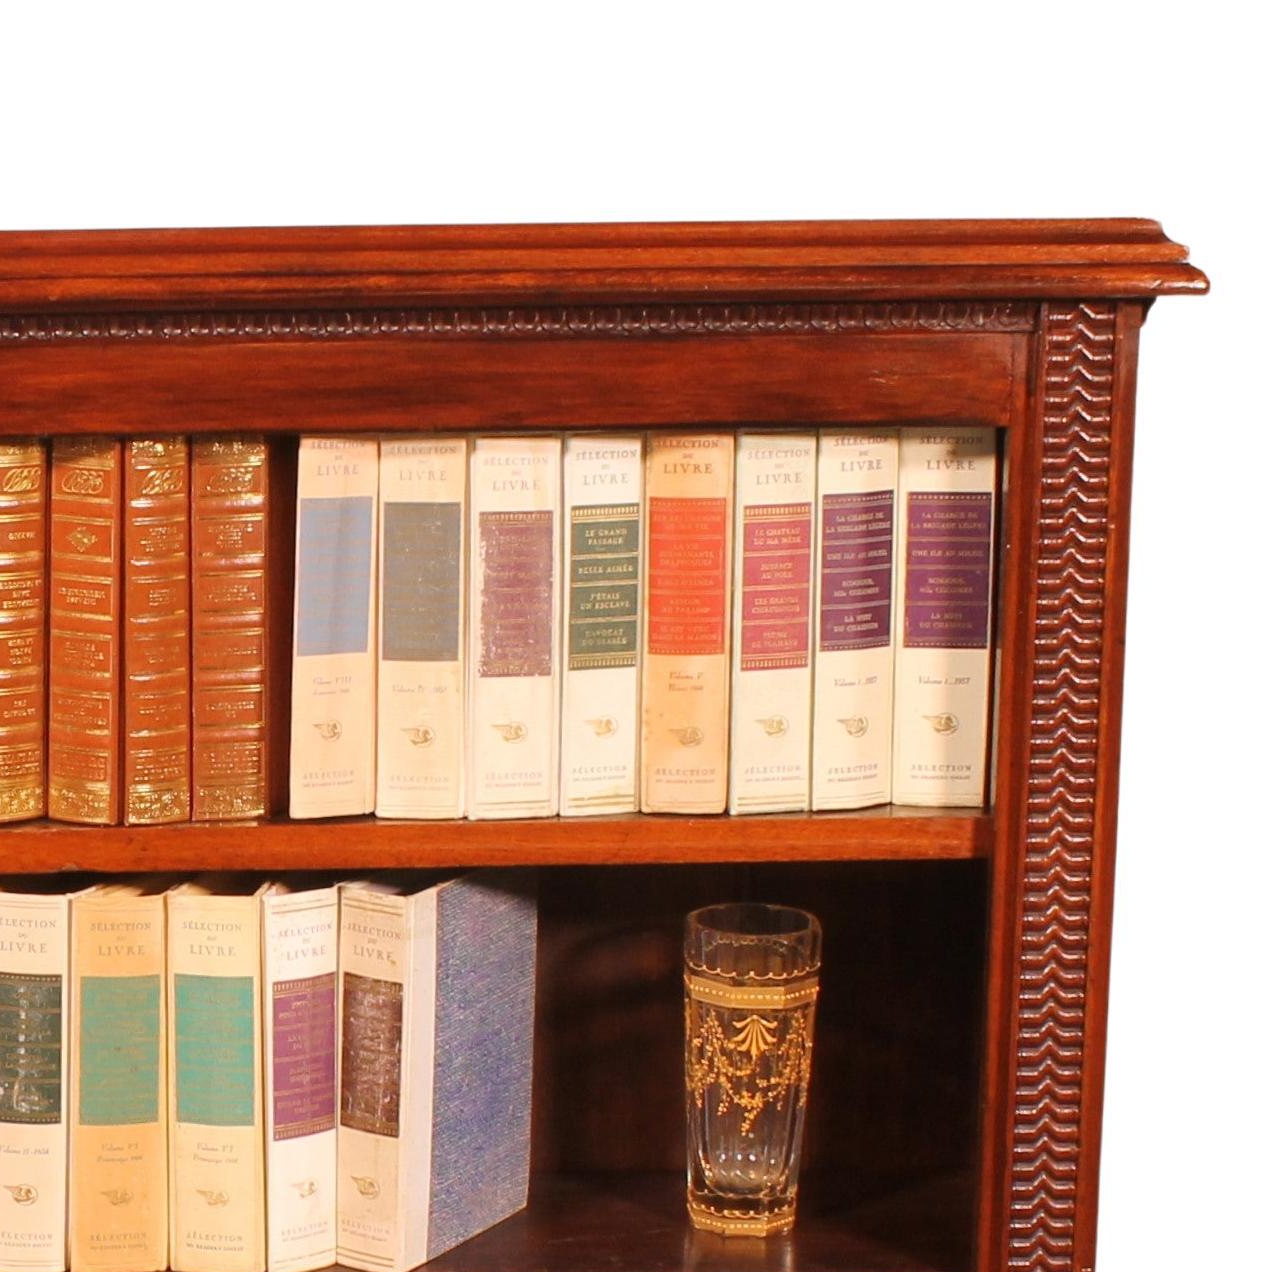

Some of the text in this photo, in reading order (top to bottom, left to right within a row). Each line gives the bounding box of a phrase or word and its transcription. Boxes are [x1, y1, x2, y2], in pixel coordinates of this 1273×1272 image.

[663, 462, 713, 473] LIVRE
[927, 459, 976, 471] LIVRE
[0, 940, 48, 954] LIVRE
